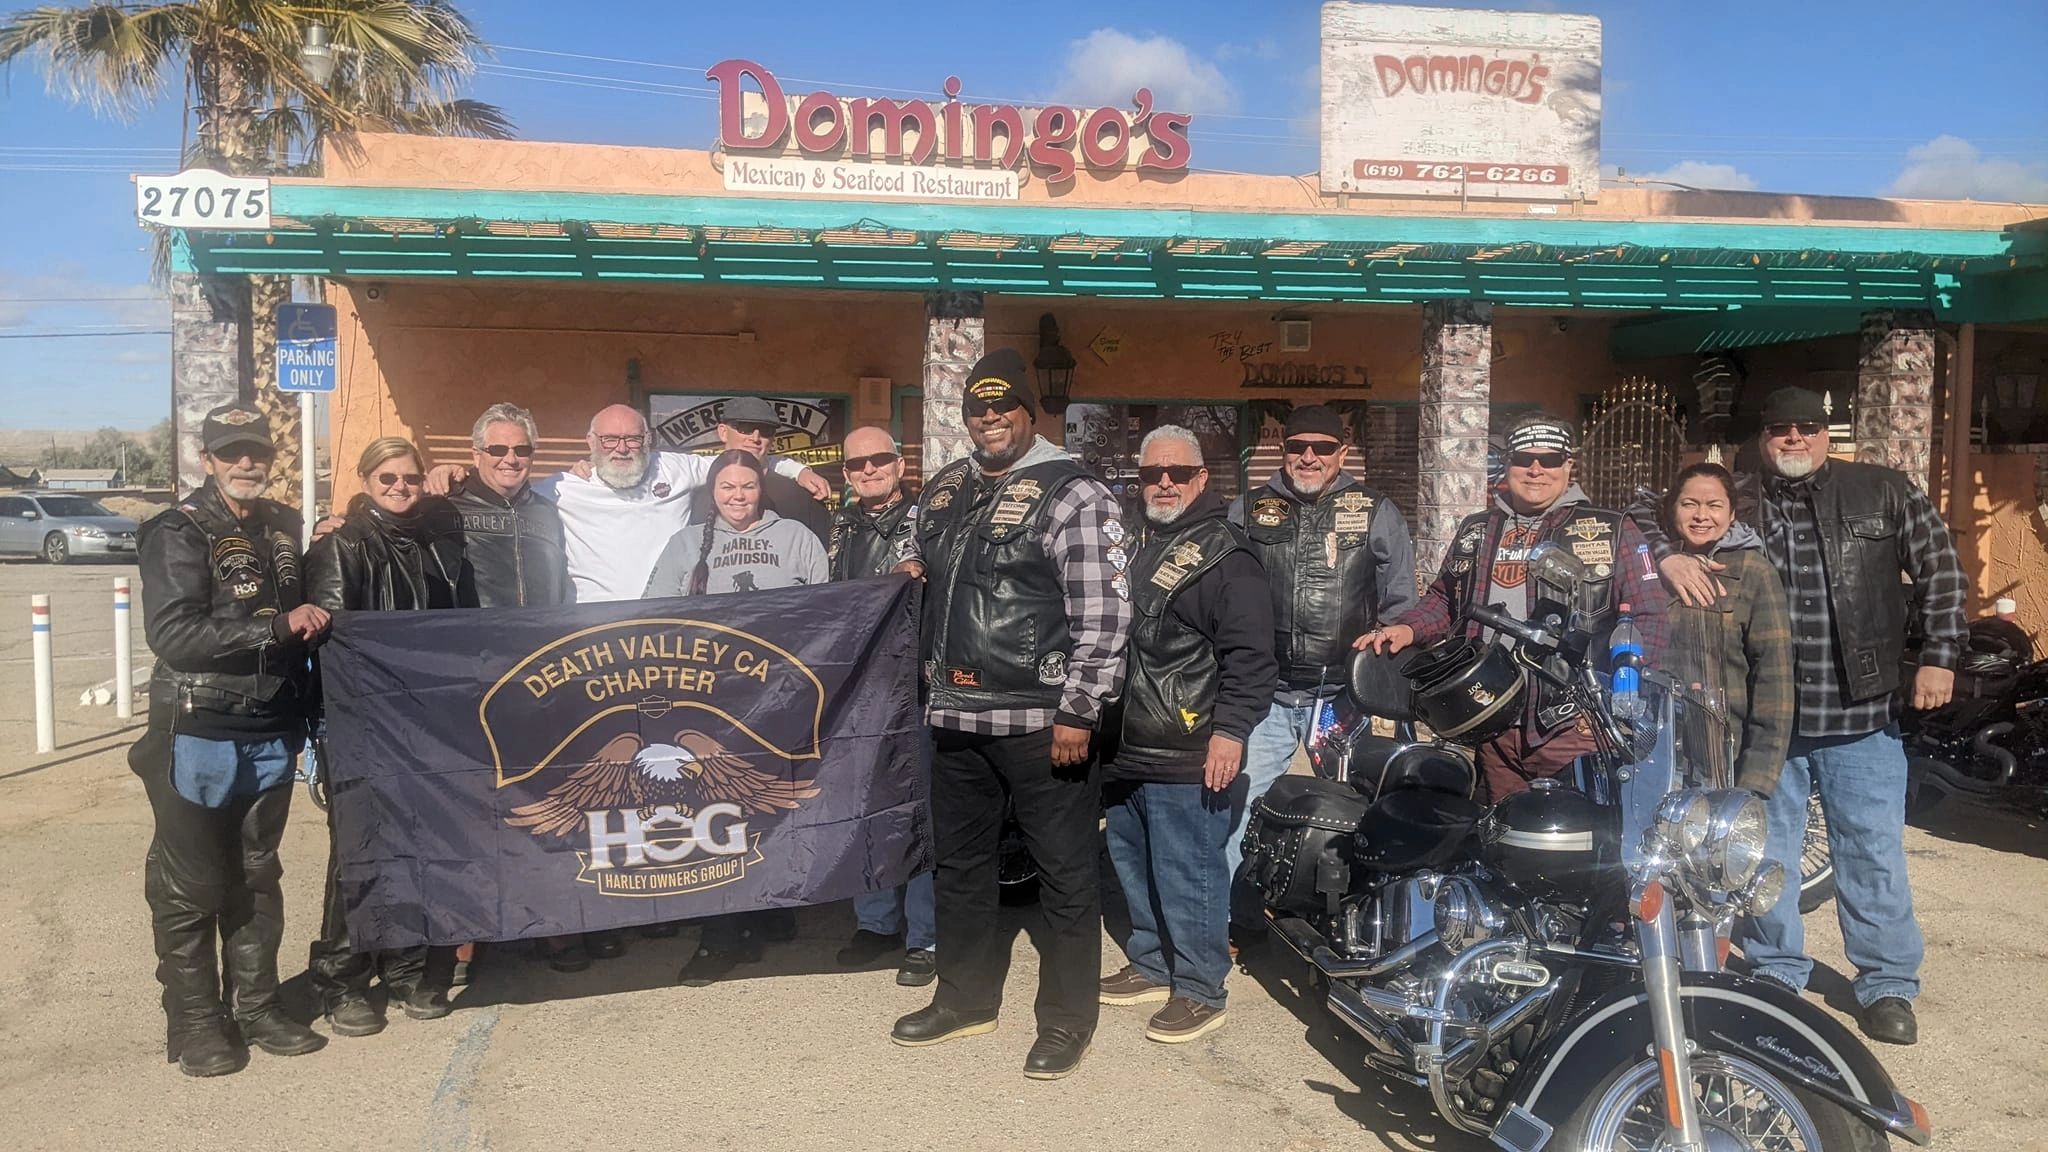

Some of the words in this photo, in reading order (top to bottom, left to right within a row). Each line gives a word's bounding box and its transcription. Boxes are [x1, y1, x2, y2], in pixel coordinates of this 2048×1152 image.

[1374, 54, 1551, 104] DOMINGO'S
[705, 59, 1192, 183] Domingo's
[732, 161, 806, 188] Mexican
[812, 167, 826, 188] &
[833, 166, 905, 193] Seafood
[912, 170, 1012, 199] Restaurant
[1363, 163, 1404, 177] (619)
[1416, 164, 1557, 183] 762-6266
[142, 187, 266, 218] 27075
[279, 349, 335, 366] PARKING
[290, 369, 324, 386] ONLY
[977, 390, 1004, 398] VETERAN
[663, 403, 725, 442] WE'RE
[712, 552, 781, 569] DAVIDSON
[722, 537, 774, 554] HARLEY-
[233, 582, 258, 596] HOG
[523, 641, 615, 699] DEATH
[618, 635, 730, 665] VALLEY
[734, 650, 770, 683] CA
[585, 666, 717, 702] CHAPTER
[583, 802, 749, 871] HOG
[605, 873, 648, 889] HARLEY
[649, 869, 698, 888] OWNERS
[700, 858, 738, 882] GROUP
